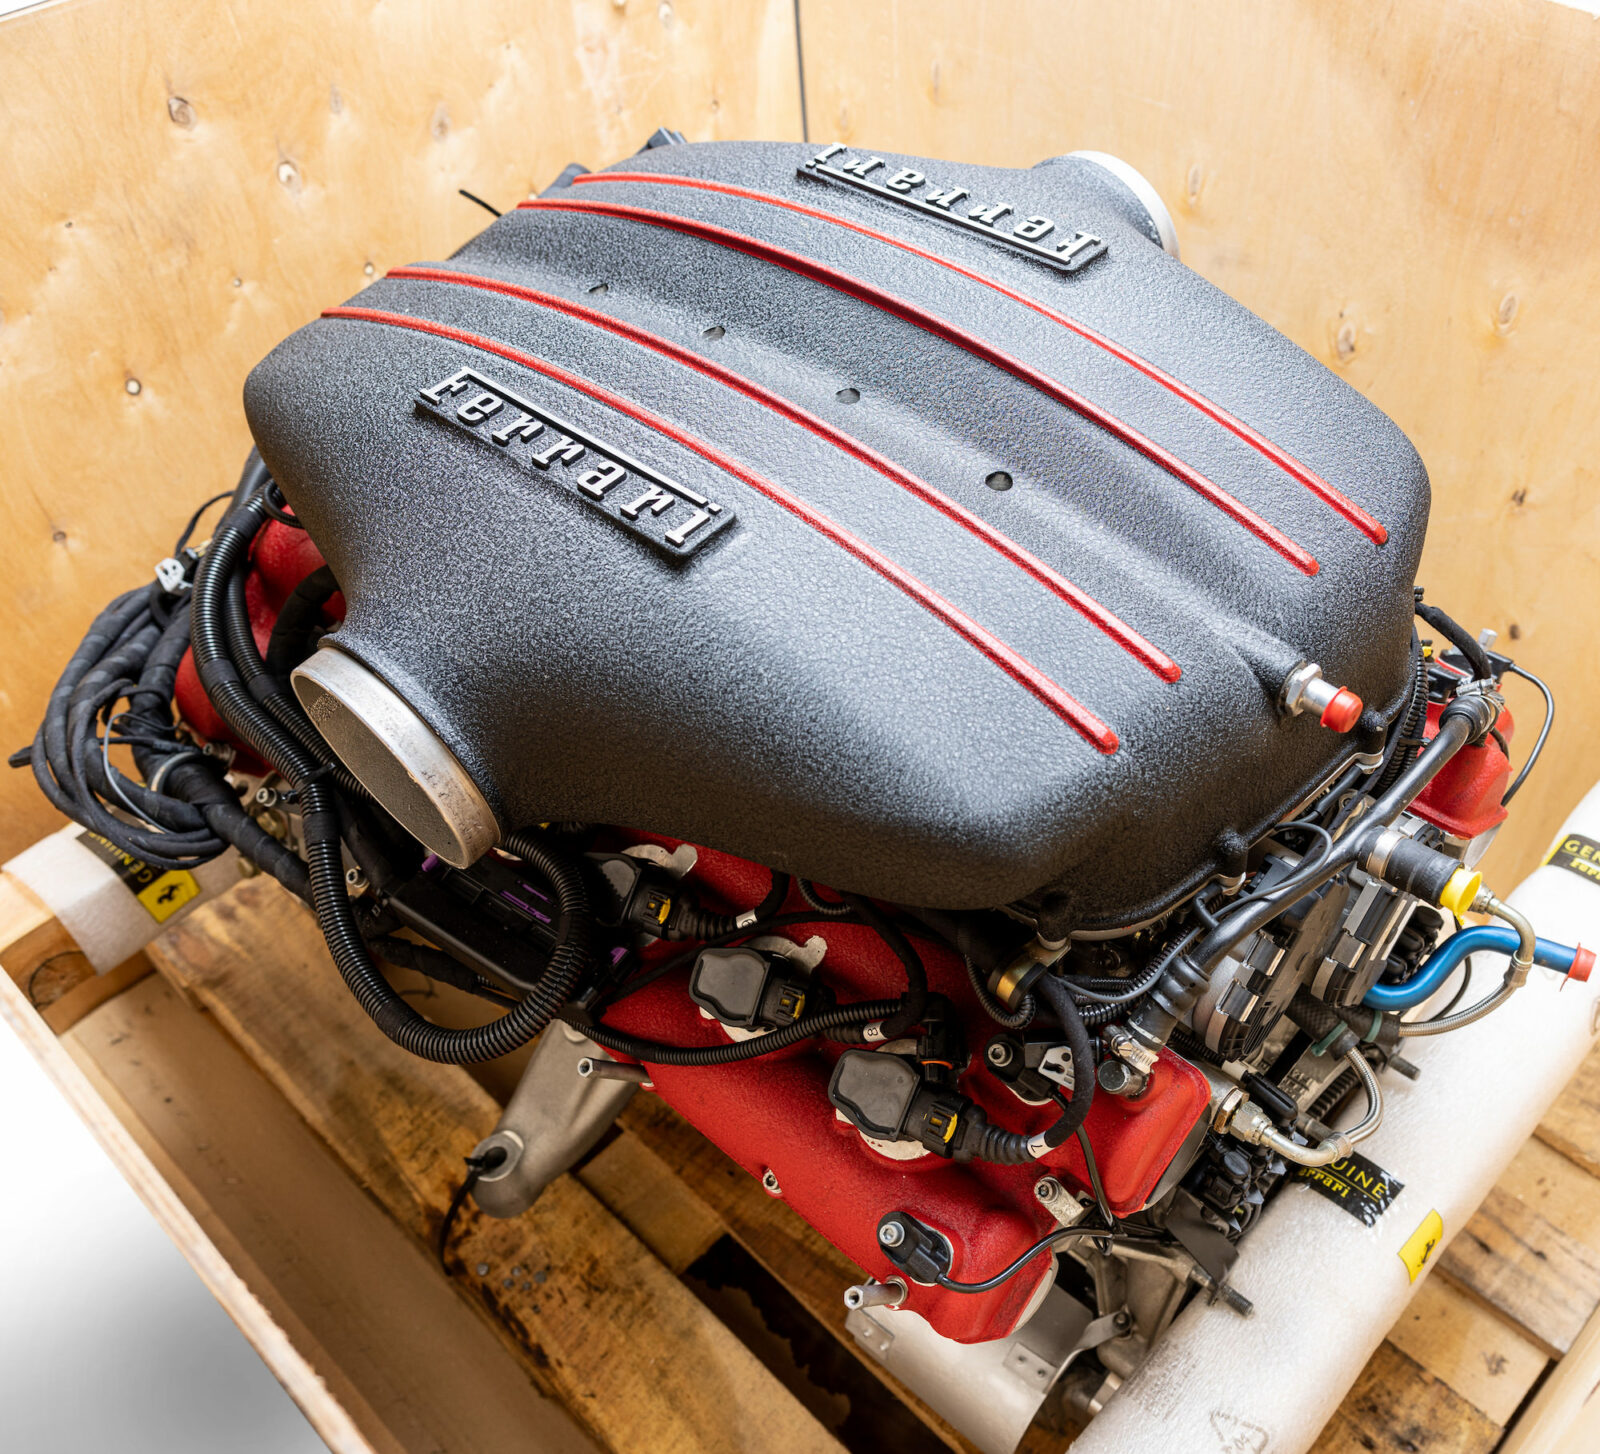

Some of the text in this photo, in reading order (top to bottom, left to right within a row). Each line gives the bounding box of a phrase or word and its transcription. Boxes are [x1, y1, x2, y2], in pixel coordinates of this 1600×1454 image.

[805, 142, 1102, 264] Ferrari
[418, 366, 722, 547] Ferrari
[867, 1027, 879, 1036] 8
[1030, 1144, 1043, 1153] 7
